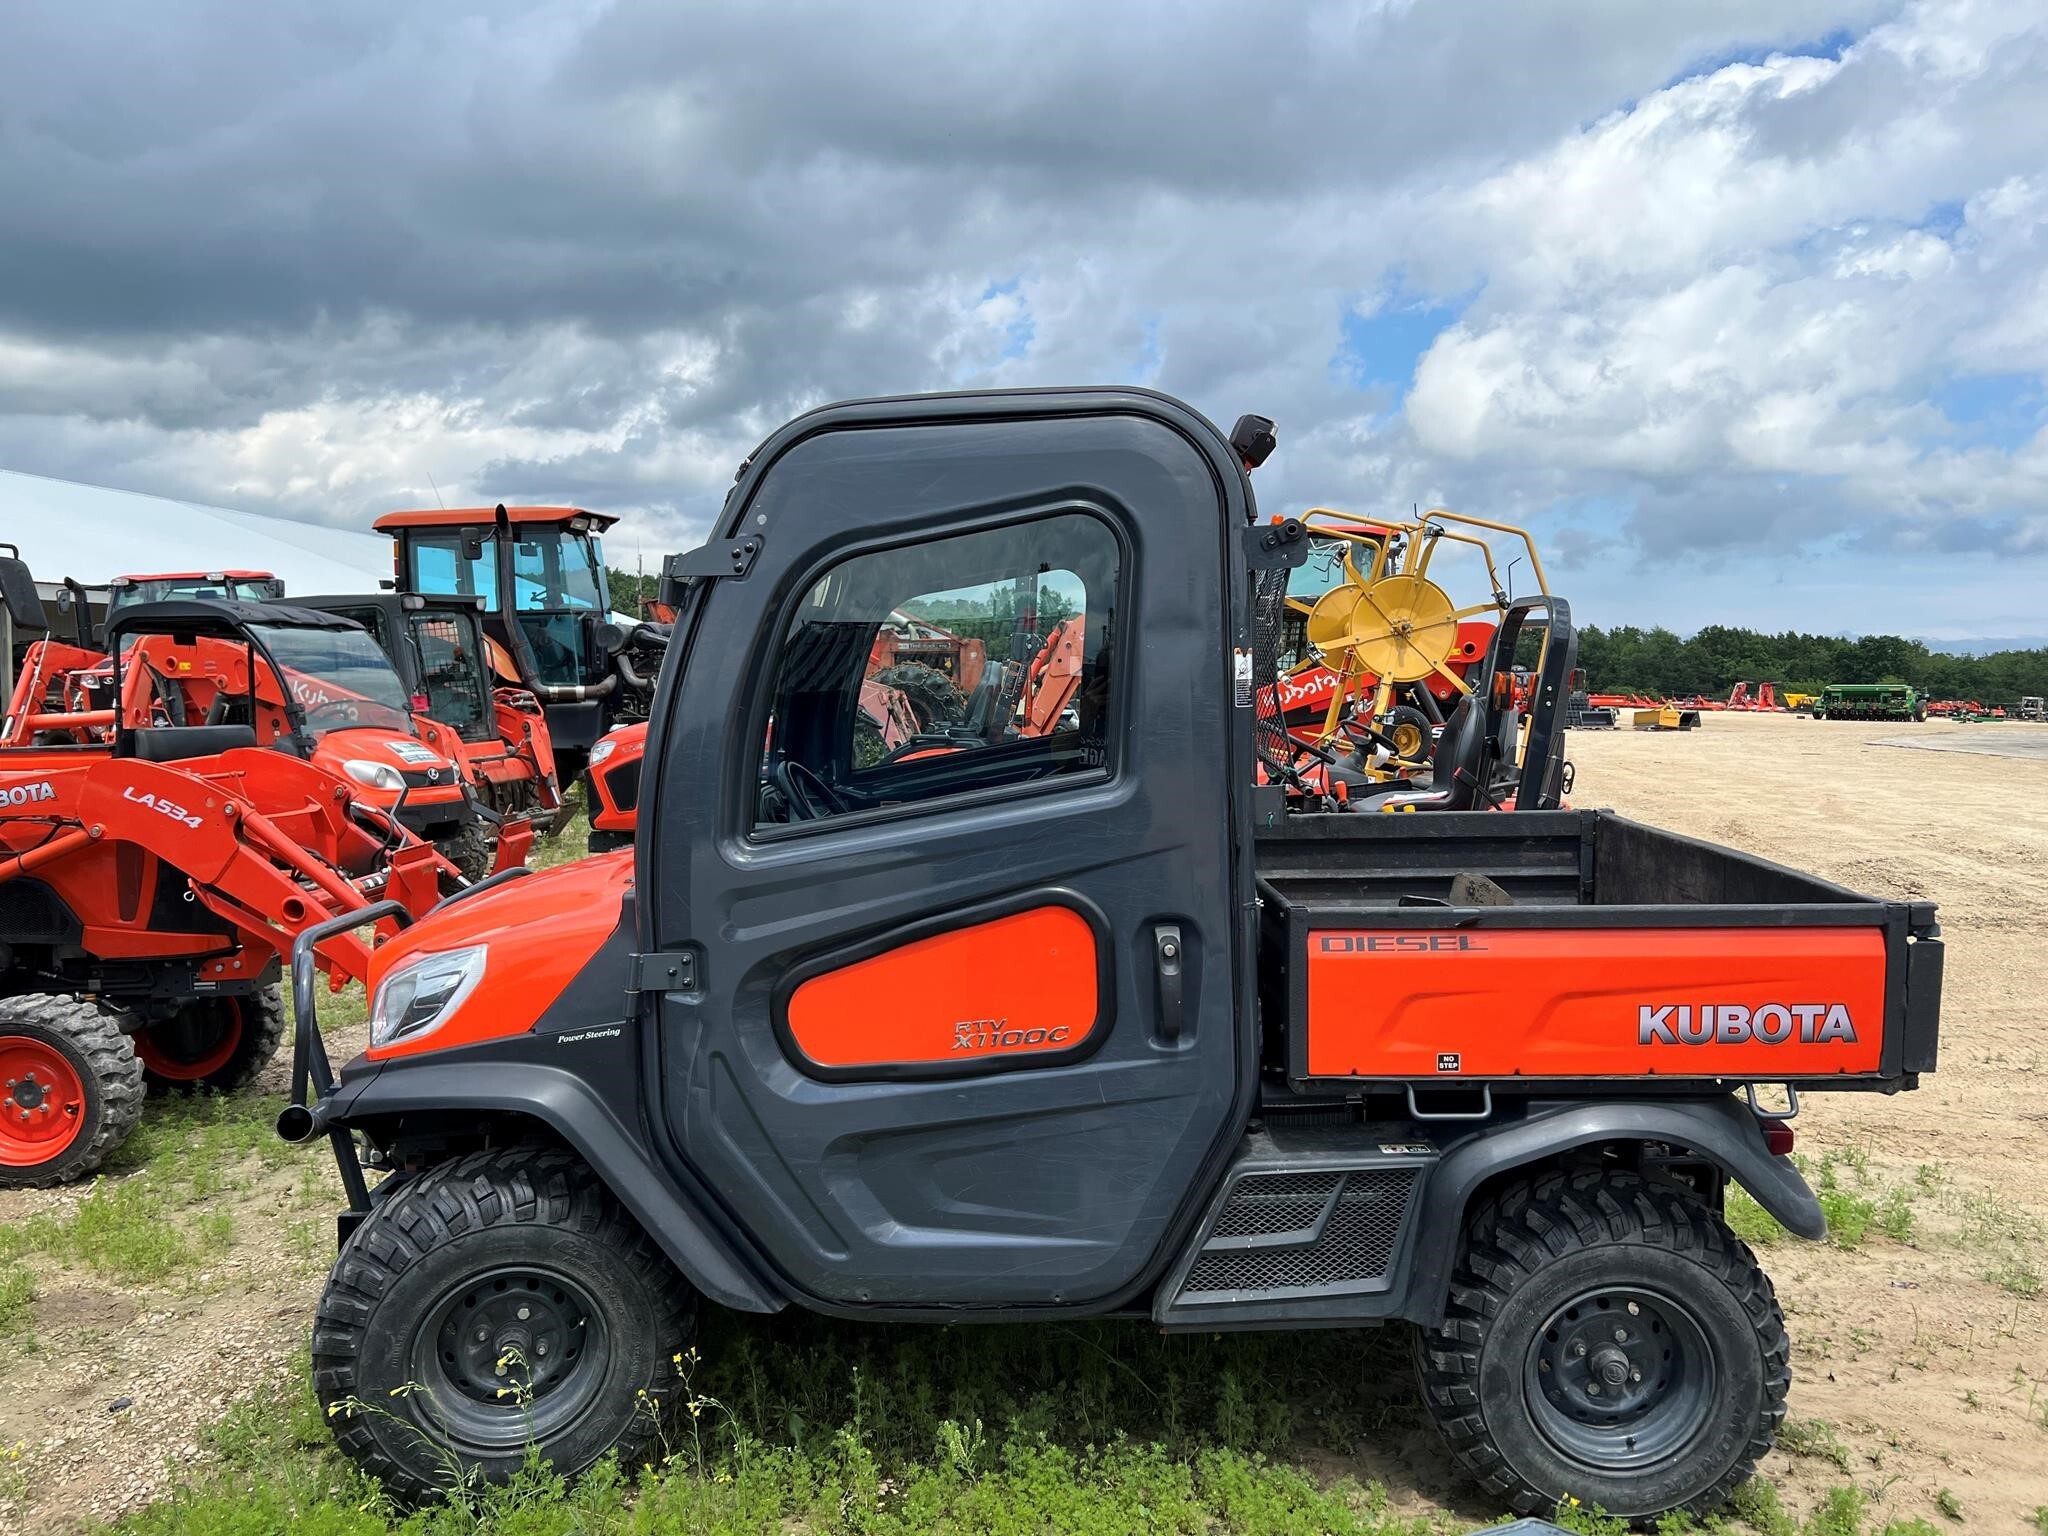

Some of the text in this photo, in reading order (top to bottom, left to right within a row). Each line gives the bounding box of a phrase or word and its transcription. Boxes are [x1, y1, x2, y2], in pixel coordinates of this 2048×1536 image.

[122, 786, 204, 829] LA534
[1321, 935, 1488, 952] DIESEL
[954, 1018, 1007, 1034] RTV
[1638, 1003, 1858, 1045] KUBOTA
[557, 1028, 621, 1044] Power Steering
[951, 1026, 1070, 1050] X1100C
